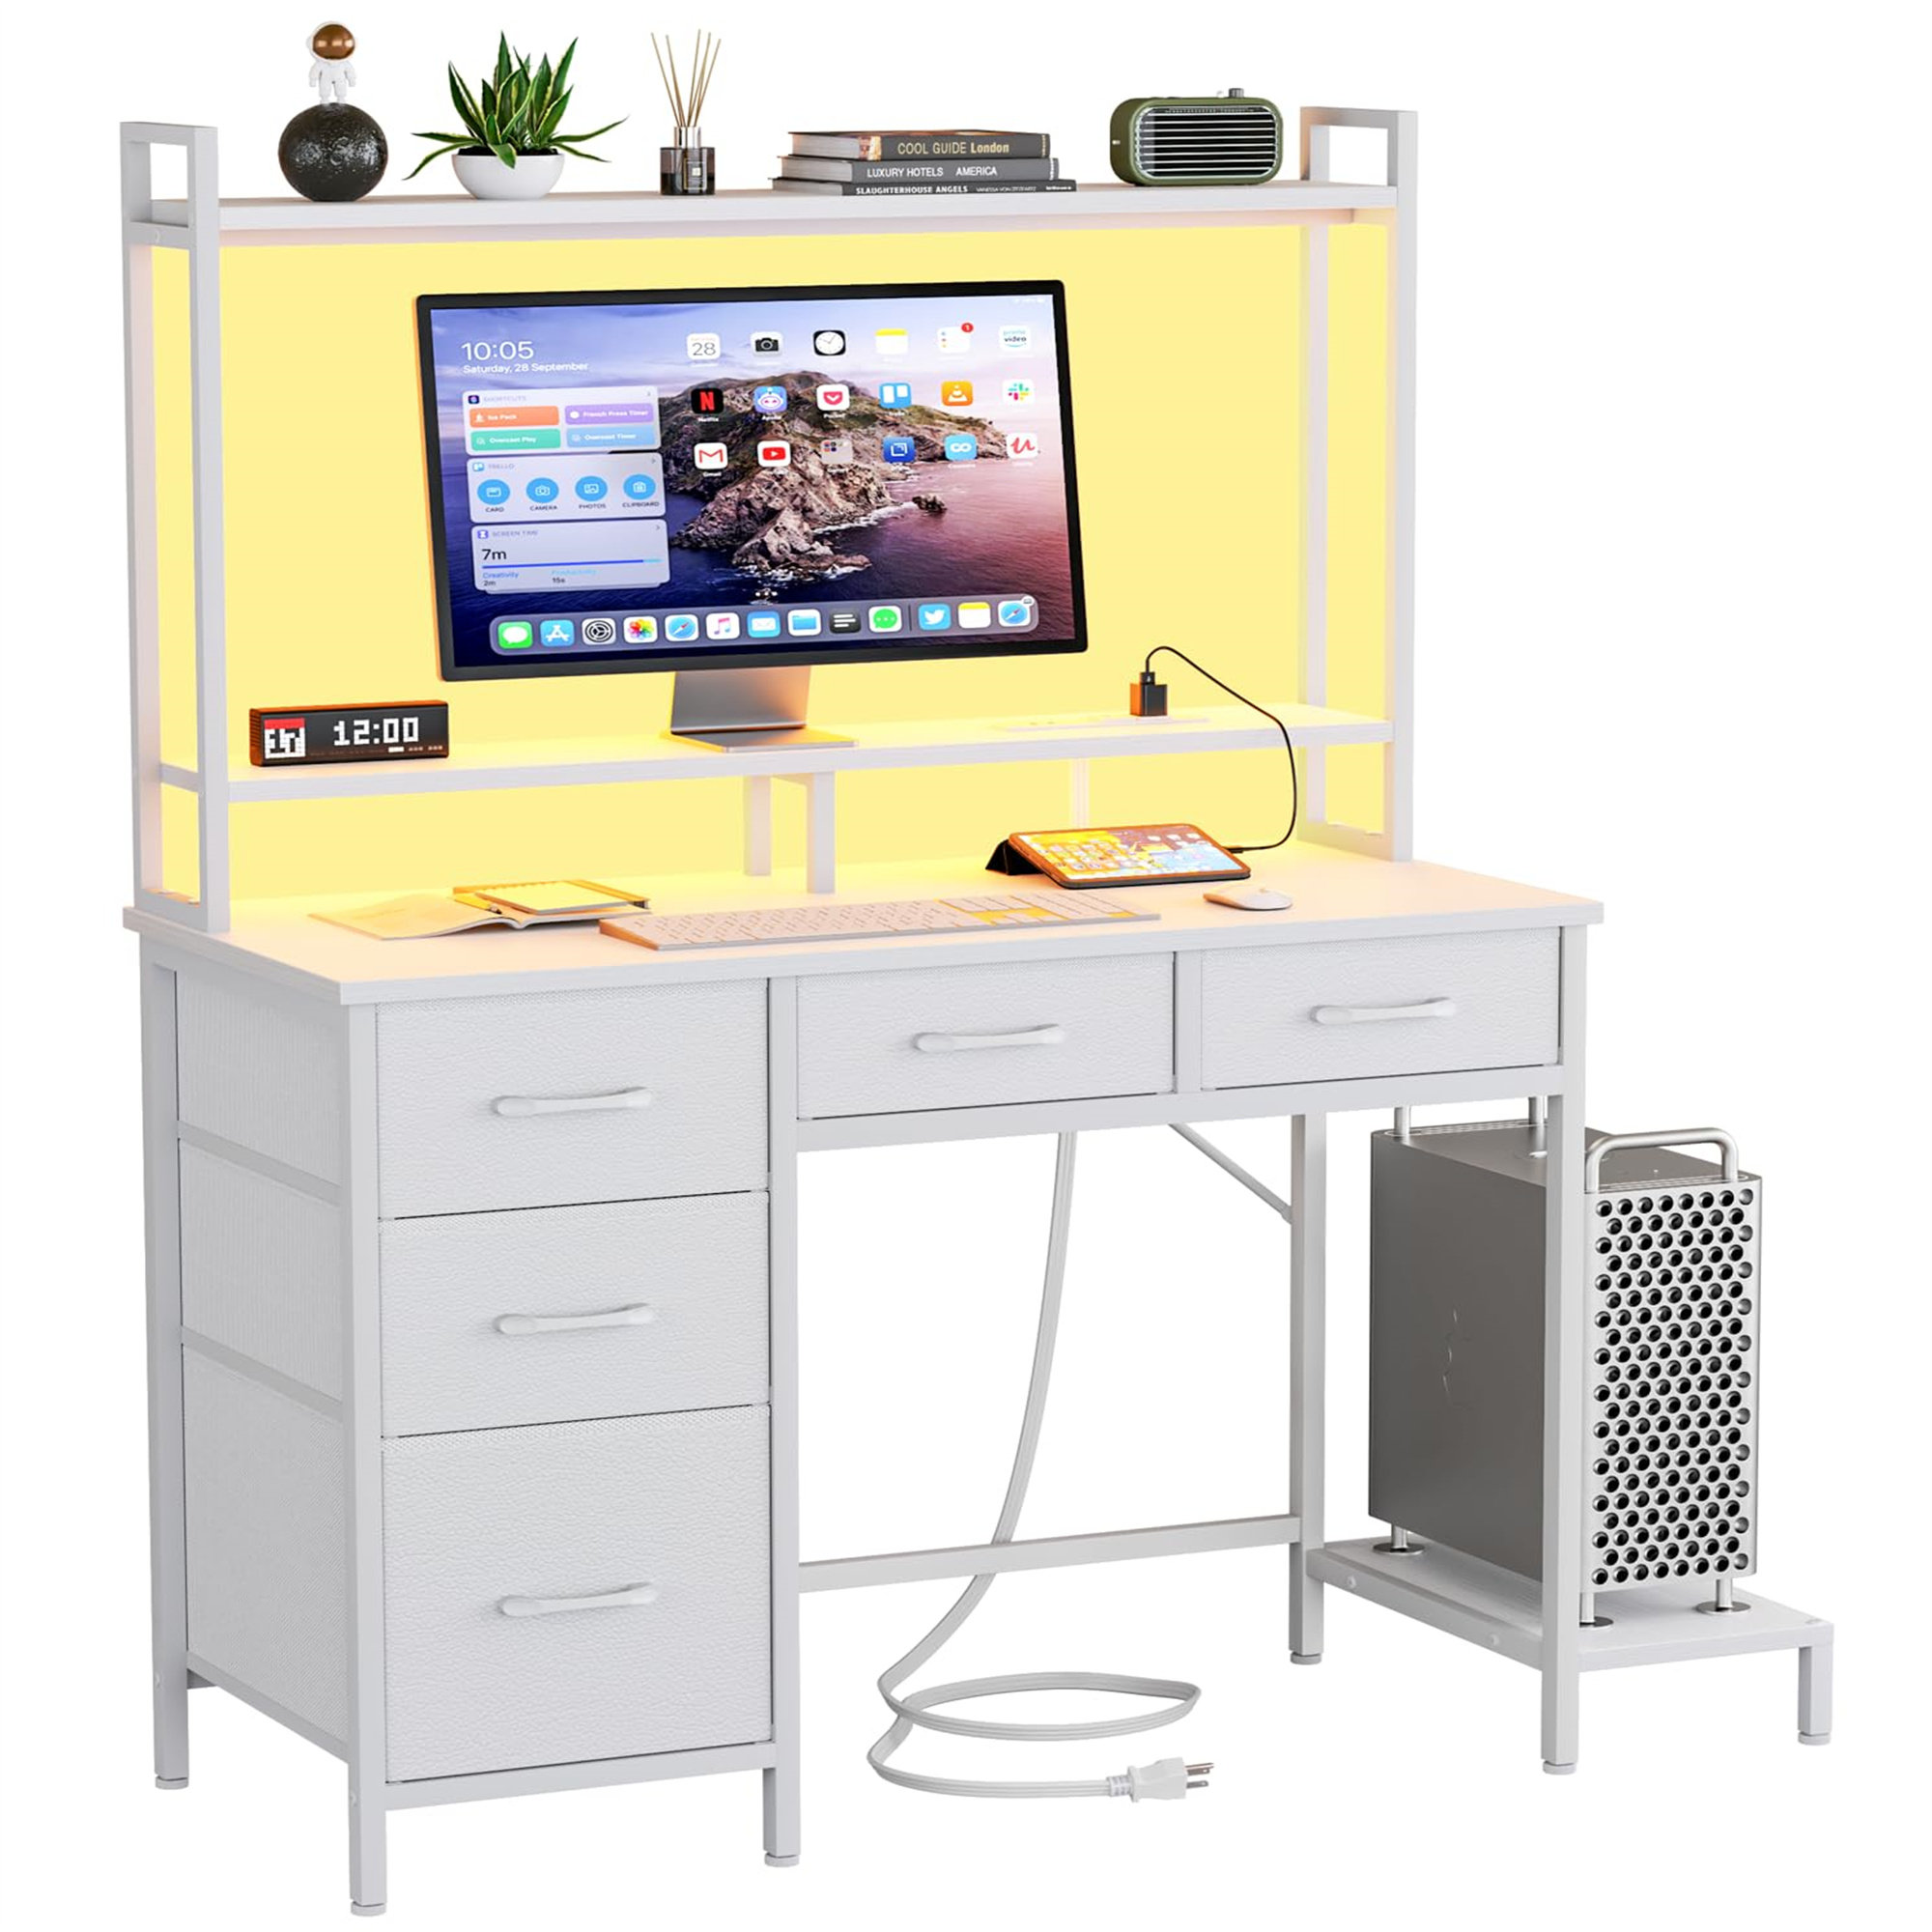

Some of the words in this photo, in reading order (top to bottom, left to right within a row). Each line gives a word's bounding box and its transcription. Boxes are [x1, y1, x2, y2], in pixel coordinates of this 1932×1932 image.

[897, 142, 928, 155] COOL
[932, 142, 966, 154] GUIDE
[970, 142, 1009, 154] London
[867, 167, 904, 178] LUXURY
[907, 166, 943, 177] HOTELS
[955, 166, 998, 176] AMERICA
[461, 341, 534, 360] 10:05
[692, 342, 716, 356] 28
[463, 364, 512, 375] Saturday,
[514, 363, 529, 372] 28
[531, 362, 588, 373] September
[482, 549, 507, 560] 7m
[333, 717, 418, 746] 12:00
